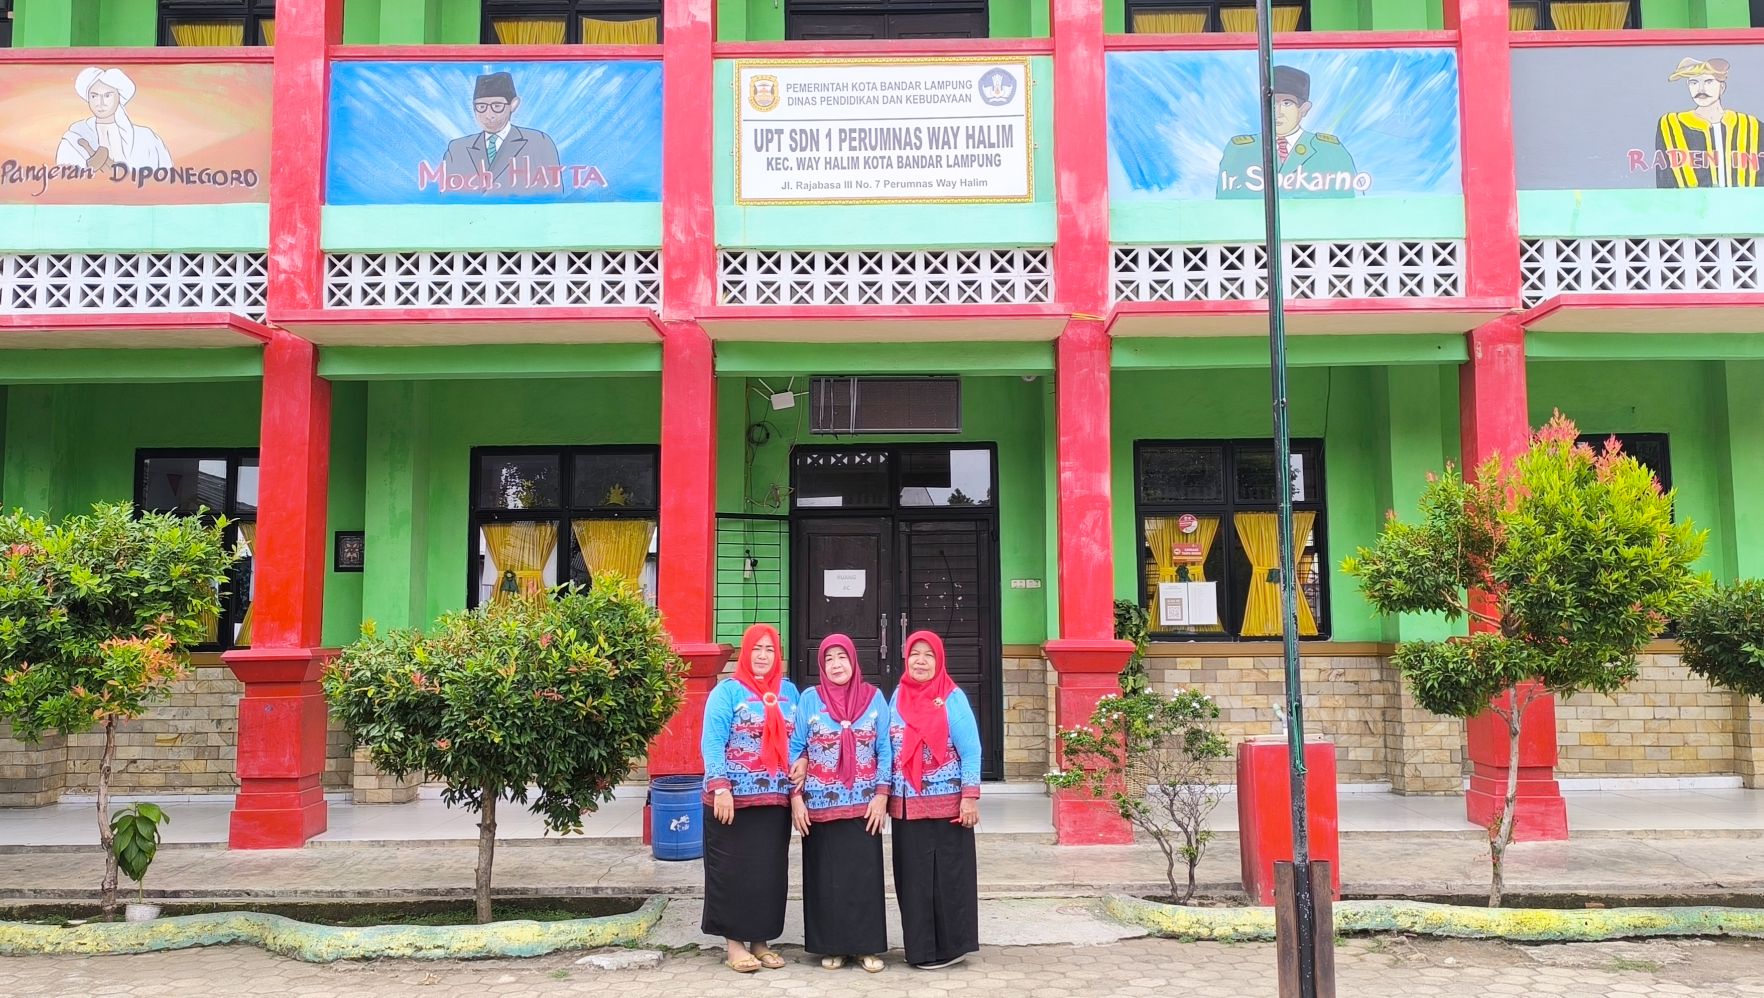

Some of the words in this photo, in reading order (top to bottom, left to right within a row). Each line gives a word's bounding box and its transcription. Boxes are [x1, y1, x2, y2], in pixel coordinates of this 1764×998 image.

[786, 82, 849, 93] PEMERINTAH
[851, 81, 878, 92] KOTA
[880, 81, 922, 92] BANDAR
[924, 79, 973, 91] LAMPUNG
[787, 96, 817, 106] DINAS
[820, 95, 879, 106] PENDIDIKAN
[882, 94, 903, 105] DAN
[905, 93, 972, 105] KEBUDAYAAN
[754, 128, 784, 153] UPT
[789, 128, 820, 153] SDN
[825, 127, 832, 152] 1
[838, 126, 923, 152] PERUMNAS
[926, 125, 960, 150] WAY
[965, 124, 1014, 150] HALIM
[766, 156, 793, 171] KEC.
[796, 156, 821, 171] WAY
[824, 156, 860, 170] HALIM
[863, 155, 893, 170] KOTA
[896, 154, 943, 169] BANDAR
[946, 153, 1002, 168] LAMPUNG
[1627, 148, 1720, 173] RADEN
[1732, 150, 1764, 171] IN
[0, 158, 96, 197] Pangeran
[109, 161, 259, 189] DIPONEGORO
[781, 181, 793, 190] Jl.
[796, 180, 841, 191] Rajabasa
[844, 180, 853, 189] III
[855, 180, 872, 189] No.
[874, 179, 881, 189] 7
[883, 179, 933, 189] Perumnas
[936, 178, 957, 189] Way
[960, 178, 988, 187] Halim
[1221, 170, 1242, 191] Ir.
